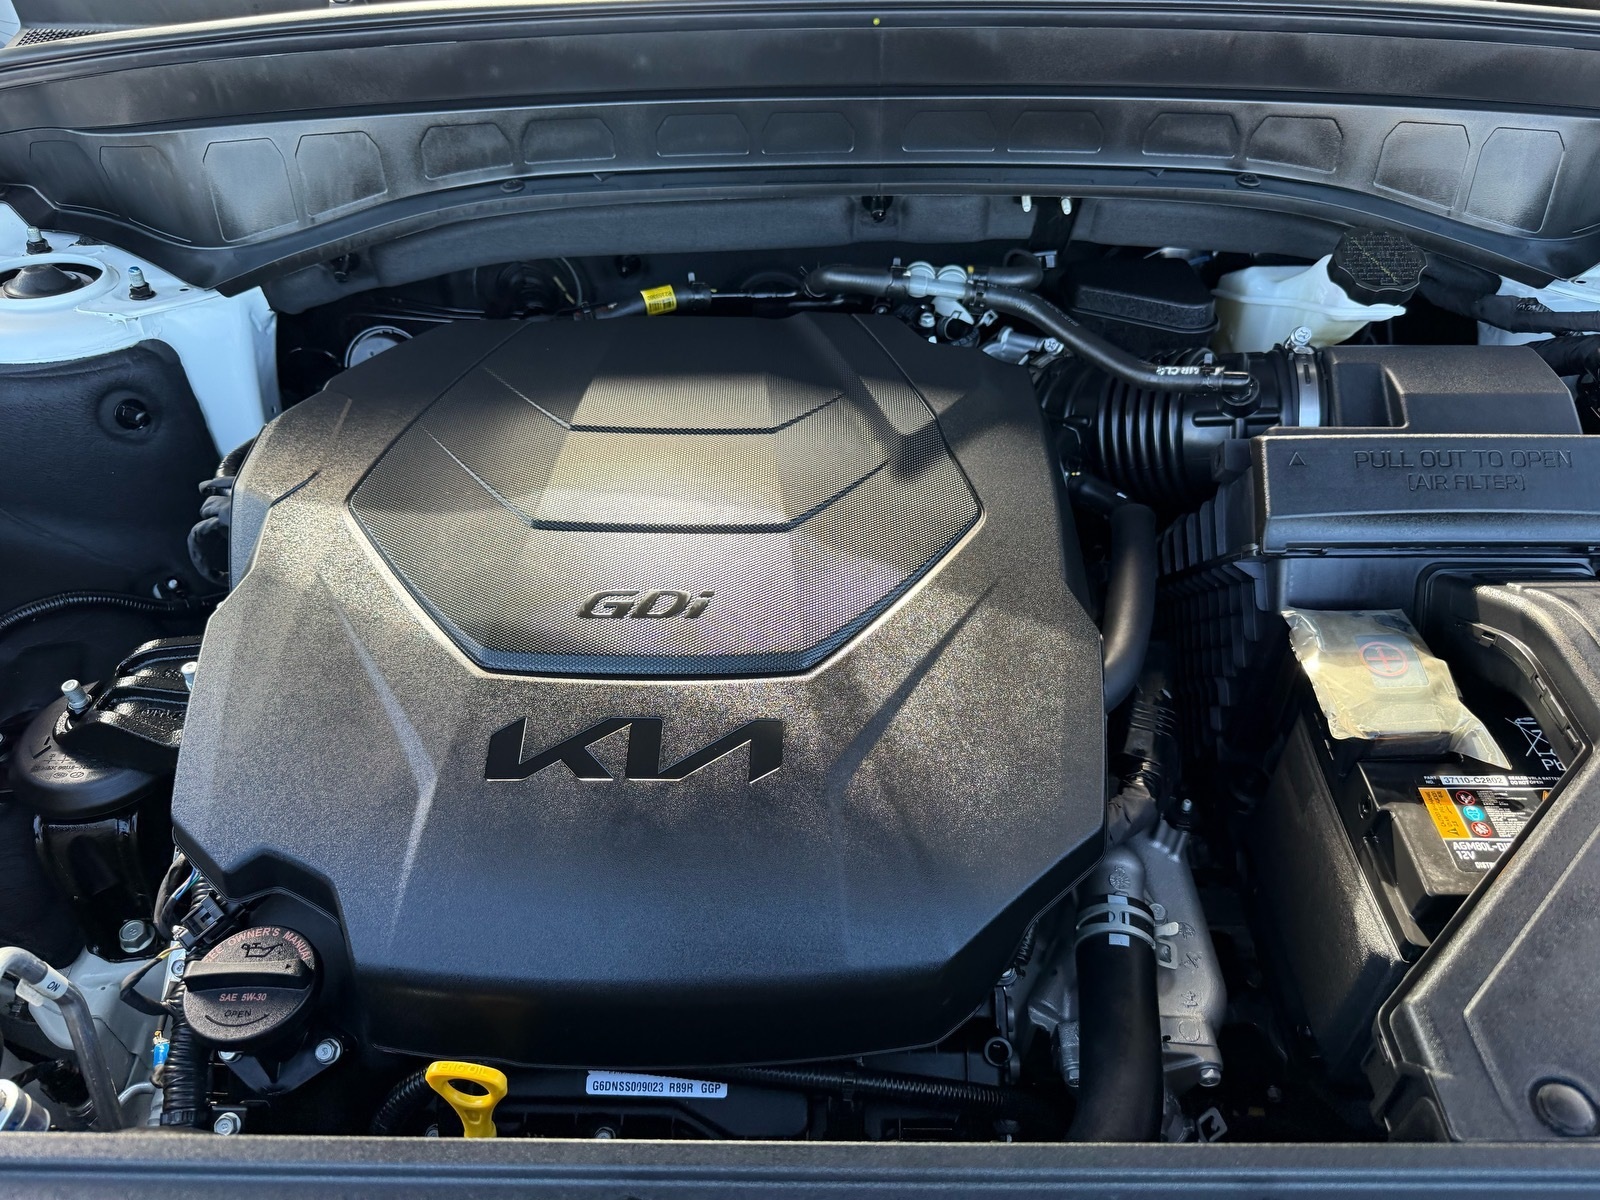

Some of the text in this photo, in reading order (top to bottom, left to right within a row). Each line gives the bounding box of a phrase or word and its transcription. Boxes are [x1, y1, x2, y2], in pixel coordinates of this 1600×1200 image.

[1353, 450, 1573, 469] PULL OUT TO OPEN
[576, 590, 716, 619] GDi
[485, 716, 783, 784] KIA
[1541, 758, 1567, 771] Pb
[1444, 776, 1504, 784] 37110-C2802
[1456, 851, 1476, 860] 12V
[227, 927, 281, 946] OWNER'S
[219, 992, 267, 1001] SAE 5W-30
[223, 1009, 252, 1018] OPEN
[439, 1062, 487, 1075] ENG OIL
[592, 1080, 721, 1094] G6DNSS009023 R89R GGP
